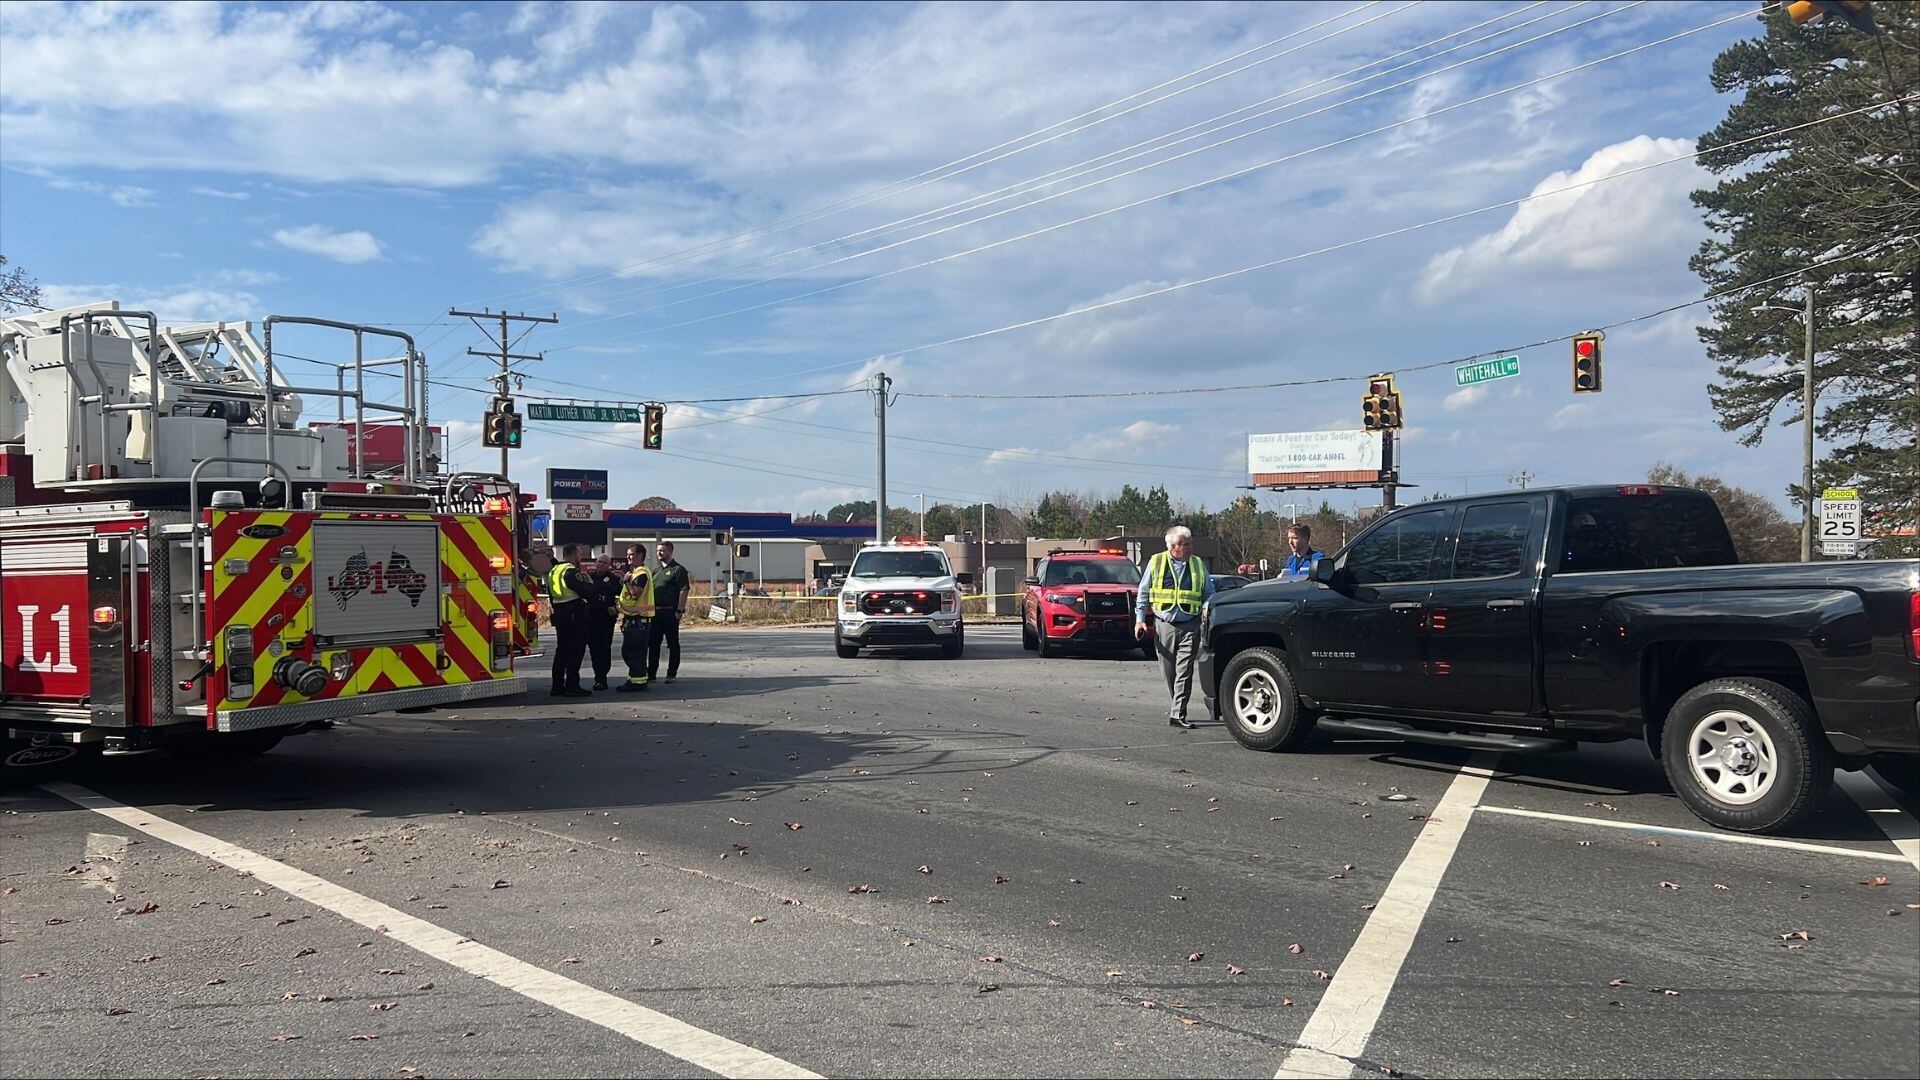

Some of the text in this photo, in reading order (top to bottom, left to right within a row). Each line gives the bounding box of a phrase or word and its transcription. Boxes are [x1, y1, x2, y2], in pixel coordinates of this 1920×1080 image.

[1458, 361, 1517, 383] WHITEHALL RD
[529, 405, 627, 421] MARTIN LUTHER KING JR BLVD
[1315, 433, 1328, 441] Car
[554, 480, 581, 488] POWER
[1824, 521, 1855, 536] 25
[18, 605, 78, 673] L1
